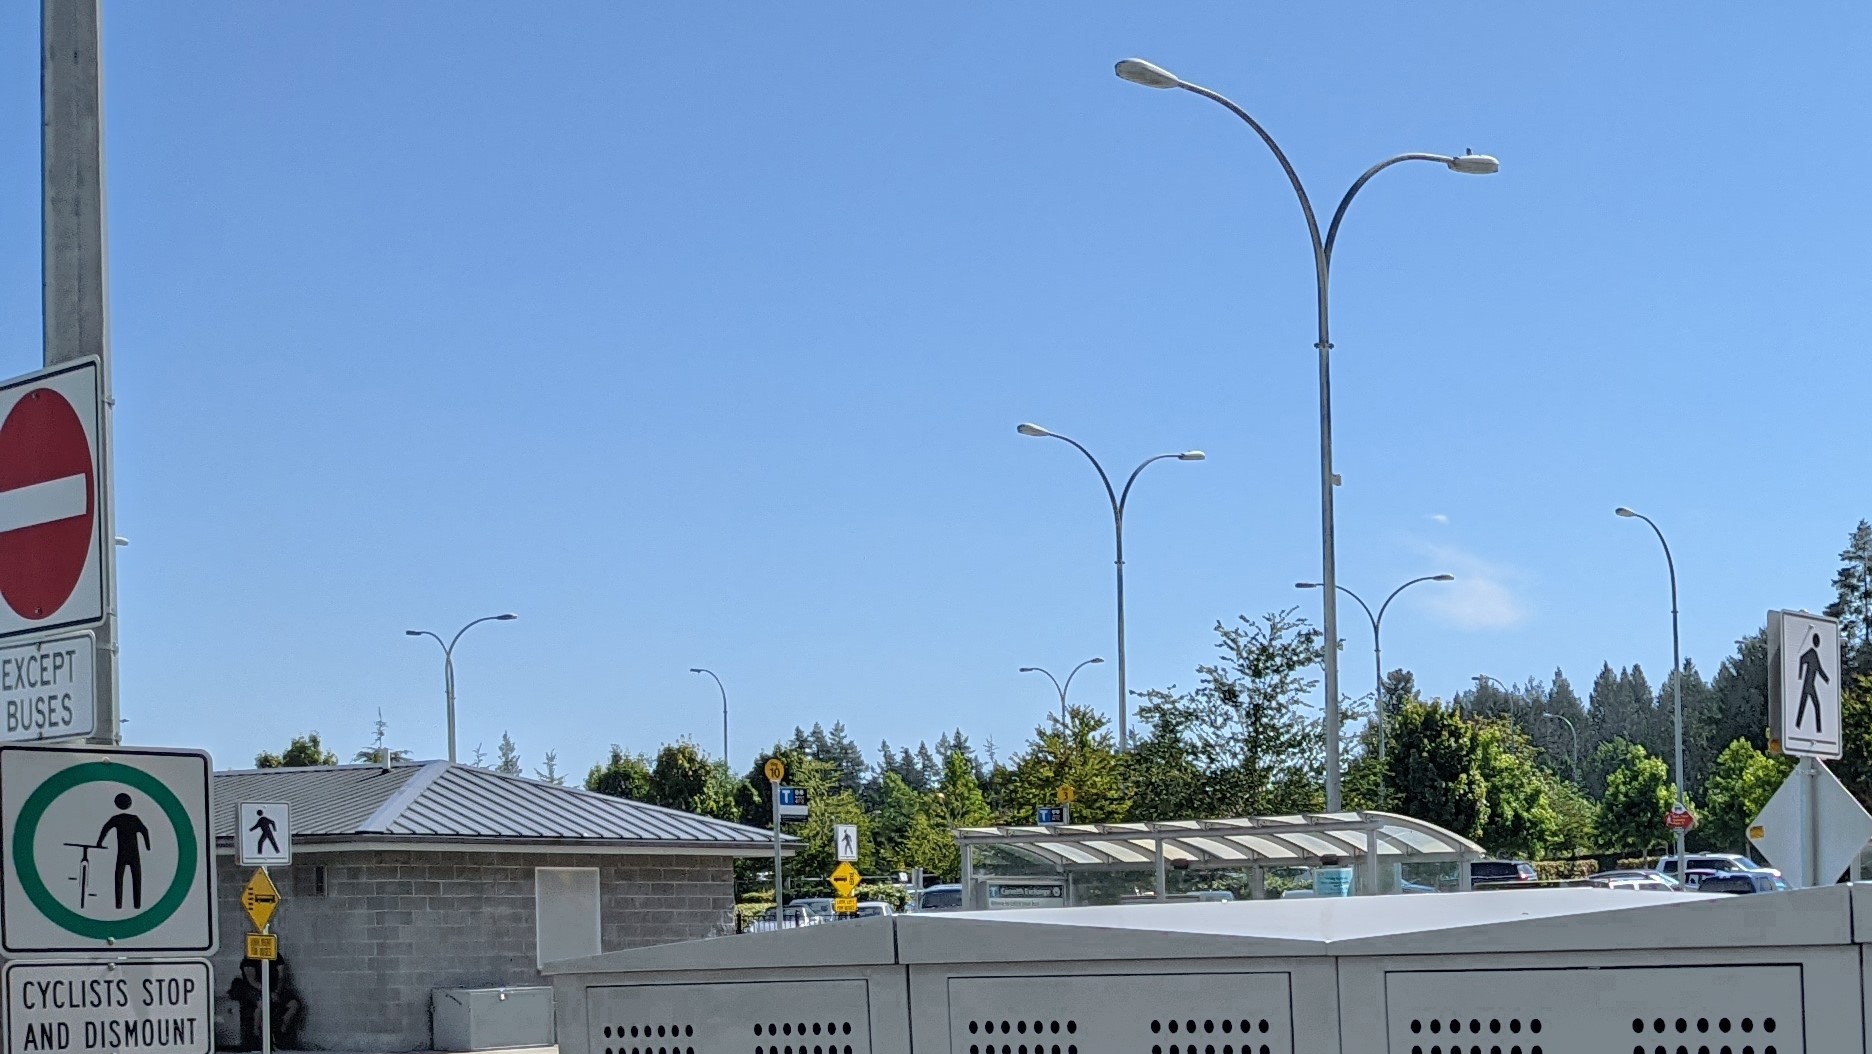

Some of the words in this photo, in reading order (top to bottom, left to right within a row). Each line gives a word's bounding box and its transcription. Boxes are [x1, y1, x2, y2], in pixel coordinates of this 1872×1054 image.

[2, 650, 76, 691] EXCEPT
[7, 693, 73, 732] BUSES
[770, 768, 780, 779] 10
[22, 979, 129, 1009] CYCLISTS
[142, 978, 195, 1007] STOP
[24, 1022, 70, 1051] AND
[85, 1018, 197, 1049] DISMOUNT
